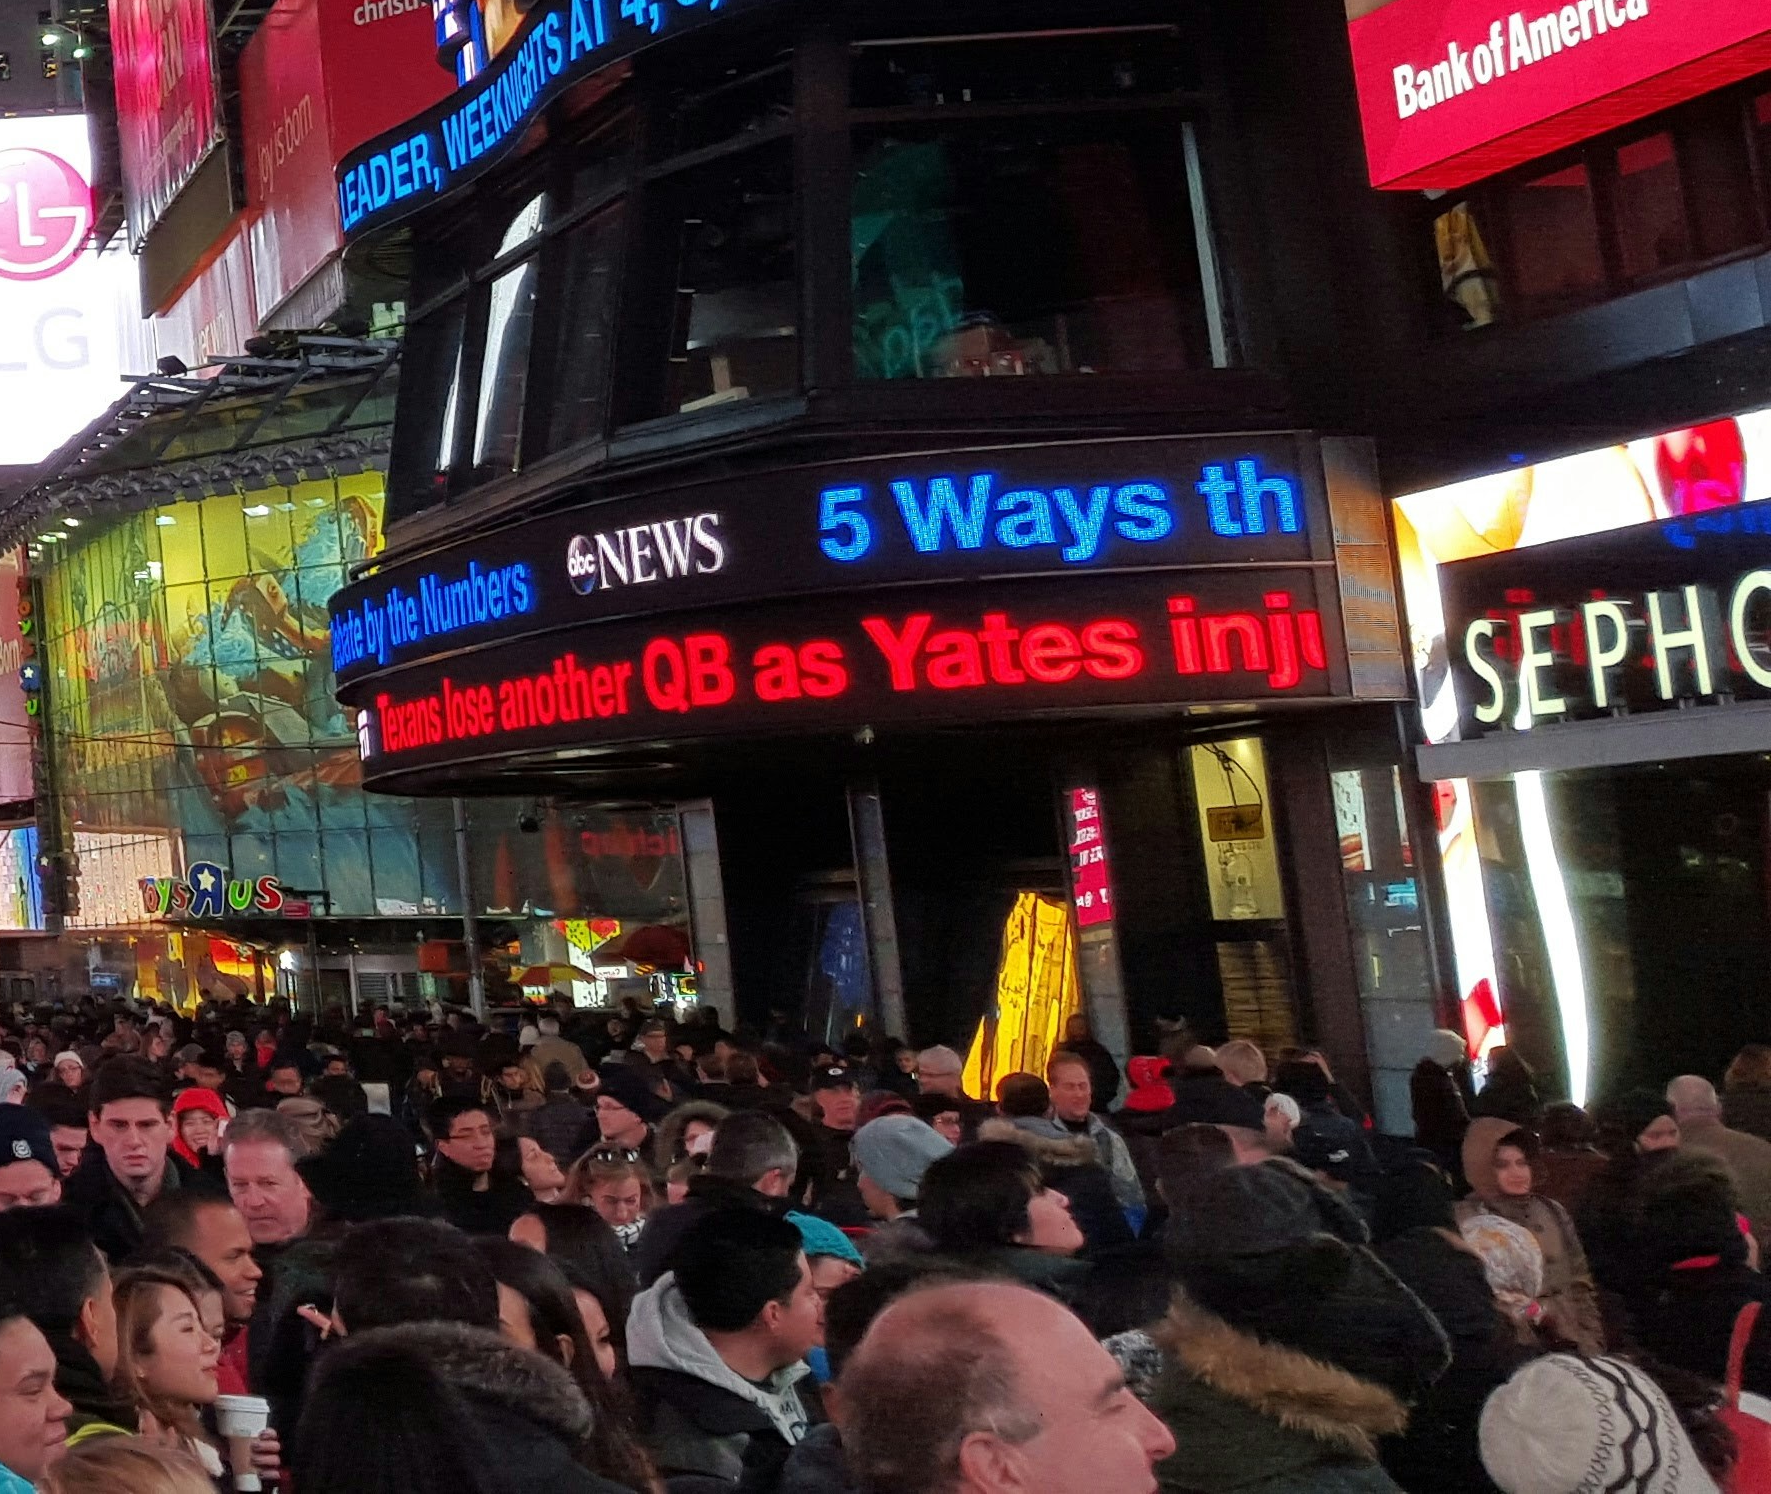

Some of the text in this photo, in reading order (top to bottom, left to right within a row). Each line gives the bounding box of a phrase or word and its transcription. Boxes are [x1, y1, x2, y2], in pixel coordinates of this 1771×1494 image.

[339, 133, 440, 233] LEADER,
[442, 20, 561, 172] WEEKNIGHTS
[1393, 54, 1473, 120] Bank
[1471, 36, 1505, 87] of
[597, 512, 726, 590] NEWS
[819, 459, 1302, 562] 5 Ways th
[364, 598, 386, 665] by
[386, 587, 418, 646] the
[419, 562, 529, 635] Numbers
[375, 693, 443, 753] Texans
[444, 677, 495, 739] lose
[501, 649, 629, 728] another
[644, 636, 734, 712] QB
[753, 644, 847, 701] as
[862, 610, 1143, 691] Yates
